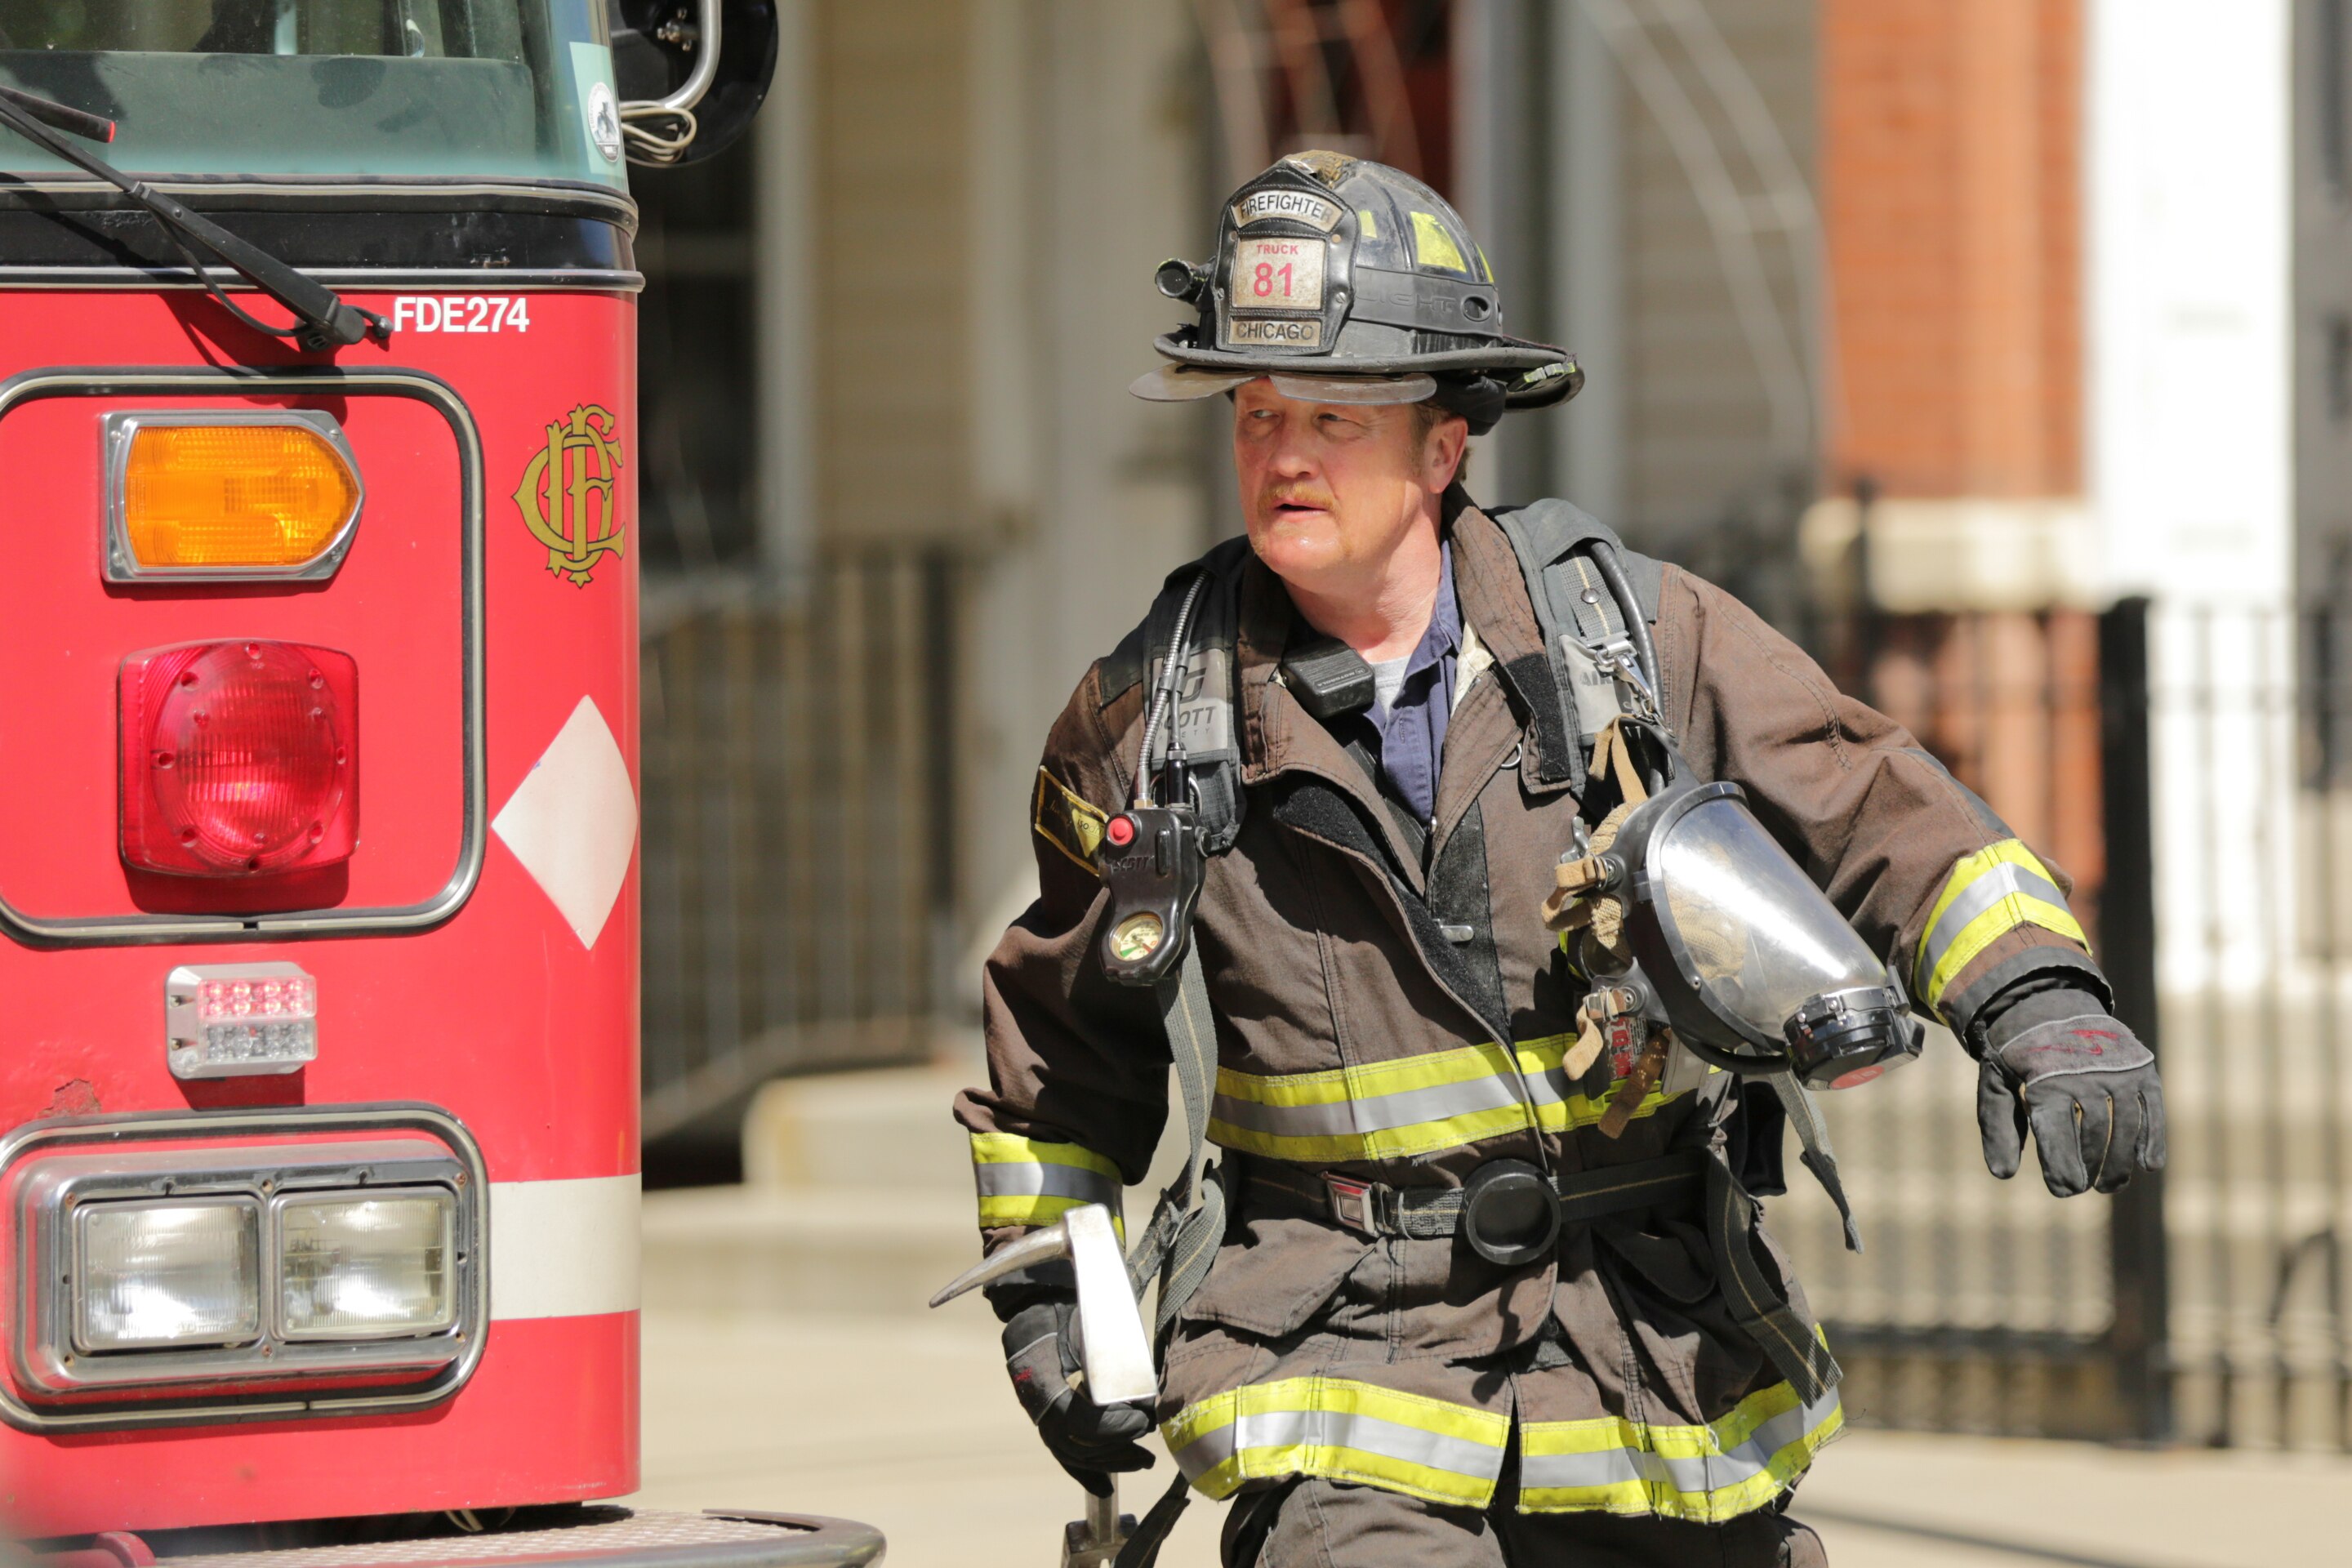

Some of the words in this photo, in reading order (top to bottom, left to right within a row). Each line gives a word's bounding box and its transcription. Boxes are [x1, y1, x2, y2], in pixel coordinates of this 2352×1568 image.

[1239, 194, 1334, 220] FIREFIGHTER
[1256, 244, 1298, 255] TRUCK
[1253, 262, 1293, 297] 81
[394, 296, 530, 333] FDE274
[1236, 323, 1313, 340] CHICAGO
[1160, 706, 1217, 730] COTT
